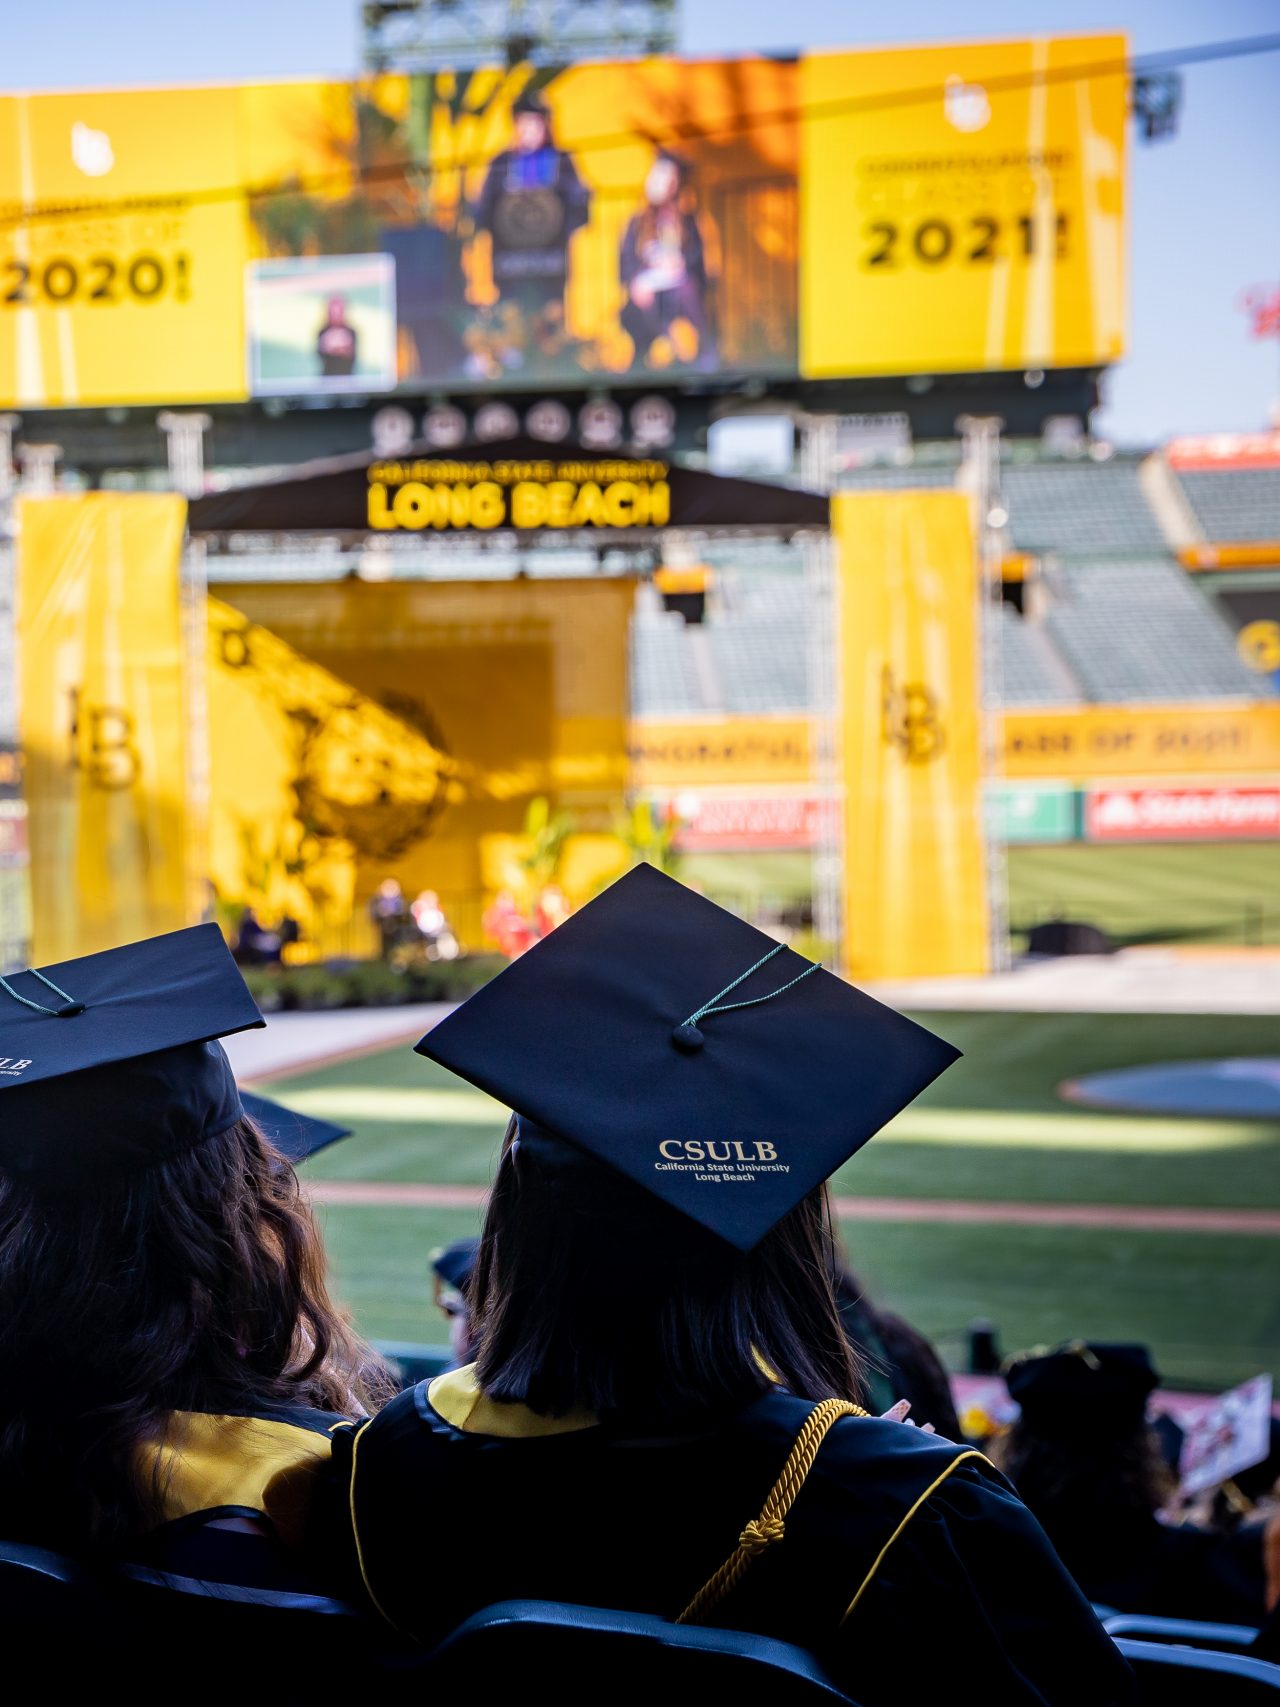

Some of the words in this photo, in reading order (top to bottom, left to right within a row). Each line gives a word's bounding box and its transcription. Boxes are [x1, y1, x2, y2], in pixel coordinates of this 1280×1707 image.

[868, 212, 1069, 266] 2021!
[2, 252, 188, 304] 2020!
[368, 481, 506, 530] LONG
[511, 480, 669, 528] BEACH
[654, 1162, 705, 1171] California
[707, 1163, 734, 1172] State
[736, 1164, 790, 1174] University
[659, 1140, 778, 1161] CSULB
[695, 1172, 722, 1183] Long
[722, 1173, 756, 1182] Beach
